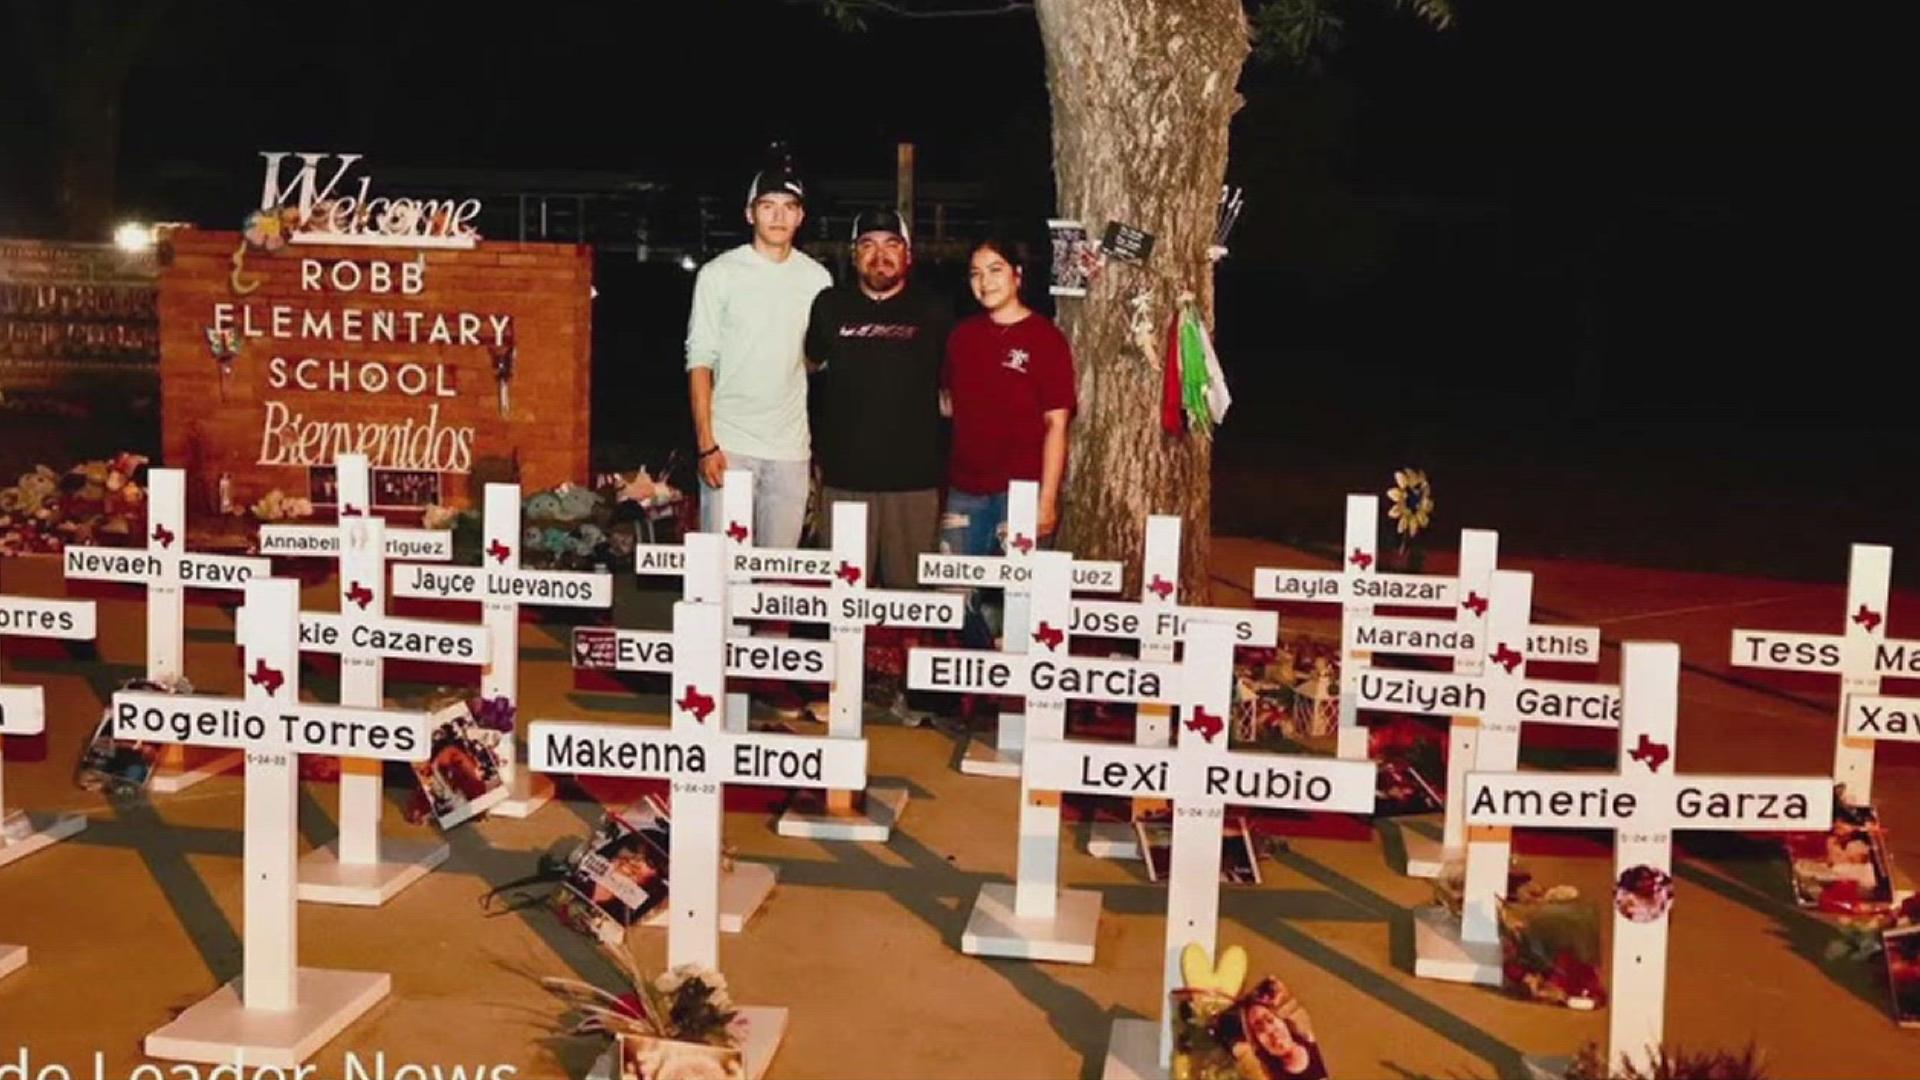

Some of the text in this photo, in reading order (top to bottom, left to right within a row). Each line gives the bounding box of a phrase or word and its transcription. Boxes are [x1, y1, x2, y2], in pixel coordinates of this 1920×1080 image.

[258, 151, 482, 236] Welcome
[302, 258, 424, 294] ROBB
[215, 302, 510, 346] ELEMENTARY
[268, 357, 456, 396] SCHOOL
[256, 400, 476, 473] Bienvenidos
[68, 552, 252, 583] Nevaeh Bravo
[735, 554, 831, 575] Ramirez
[923, 561, 1113, 585] Maite Rouez
[412, 567, 592, 601] Jayce Luevanos
[1275, 575, 1448, 600] Layla Salazar
[0, 609, 74, 631] orres
[752, 592, 953, 626] Jailah Silguero
[1069, 606, 1253, 640] Jose Fls
[300, 623, 473, 657] kie Cazares
[618, 638, 673, 664] Eva
[725, 643, 824, 673] ireles
[1356, 625, 1589, 656] Maranda this
[1746, 637, 1920, 672] Tess Ma
[931, 656, 1161, 697] Ellie Garcia
[1361, 674, 1486, 712] Uziyah
[118, 702, 416, 751] Rogelio Torres
[546, 734, 822, 781] Makenna Elrod
[1082, 755, 1332, 802] Lexi Rubio
[1471, 785, 1808, 819] Amerie Garza
